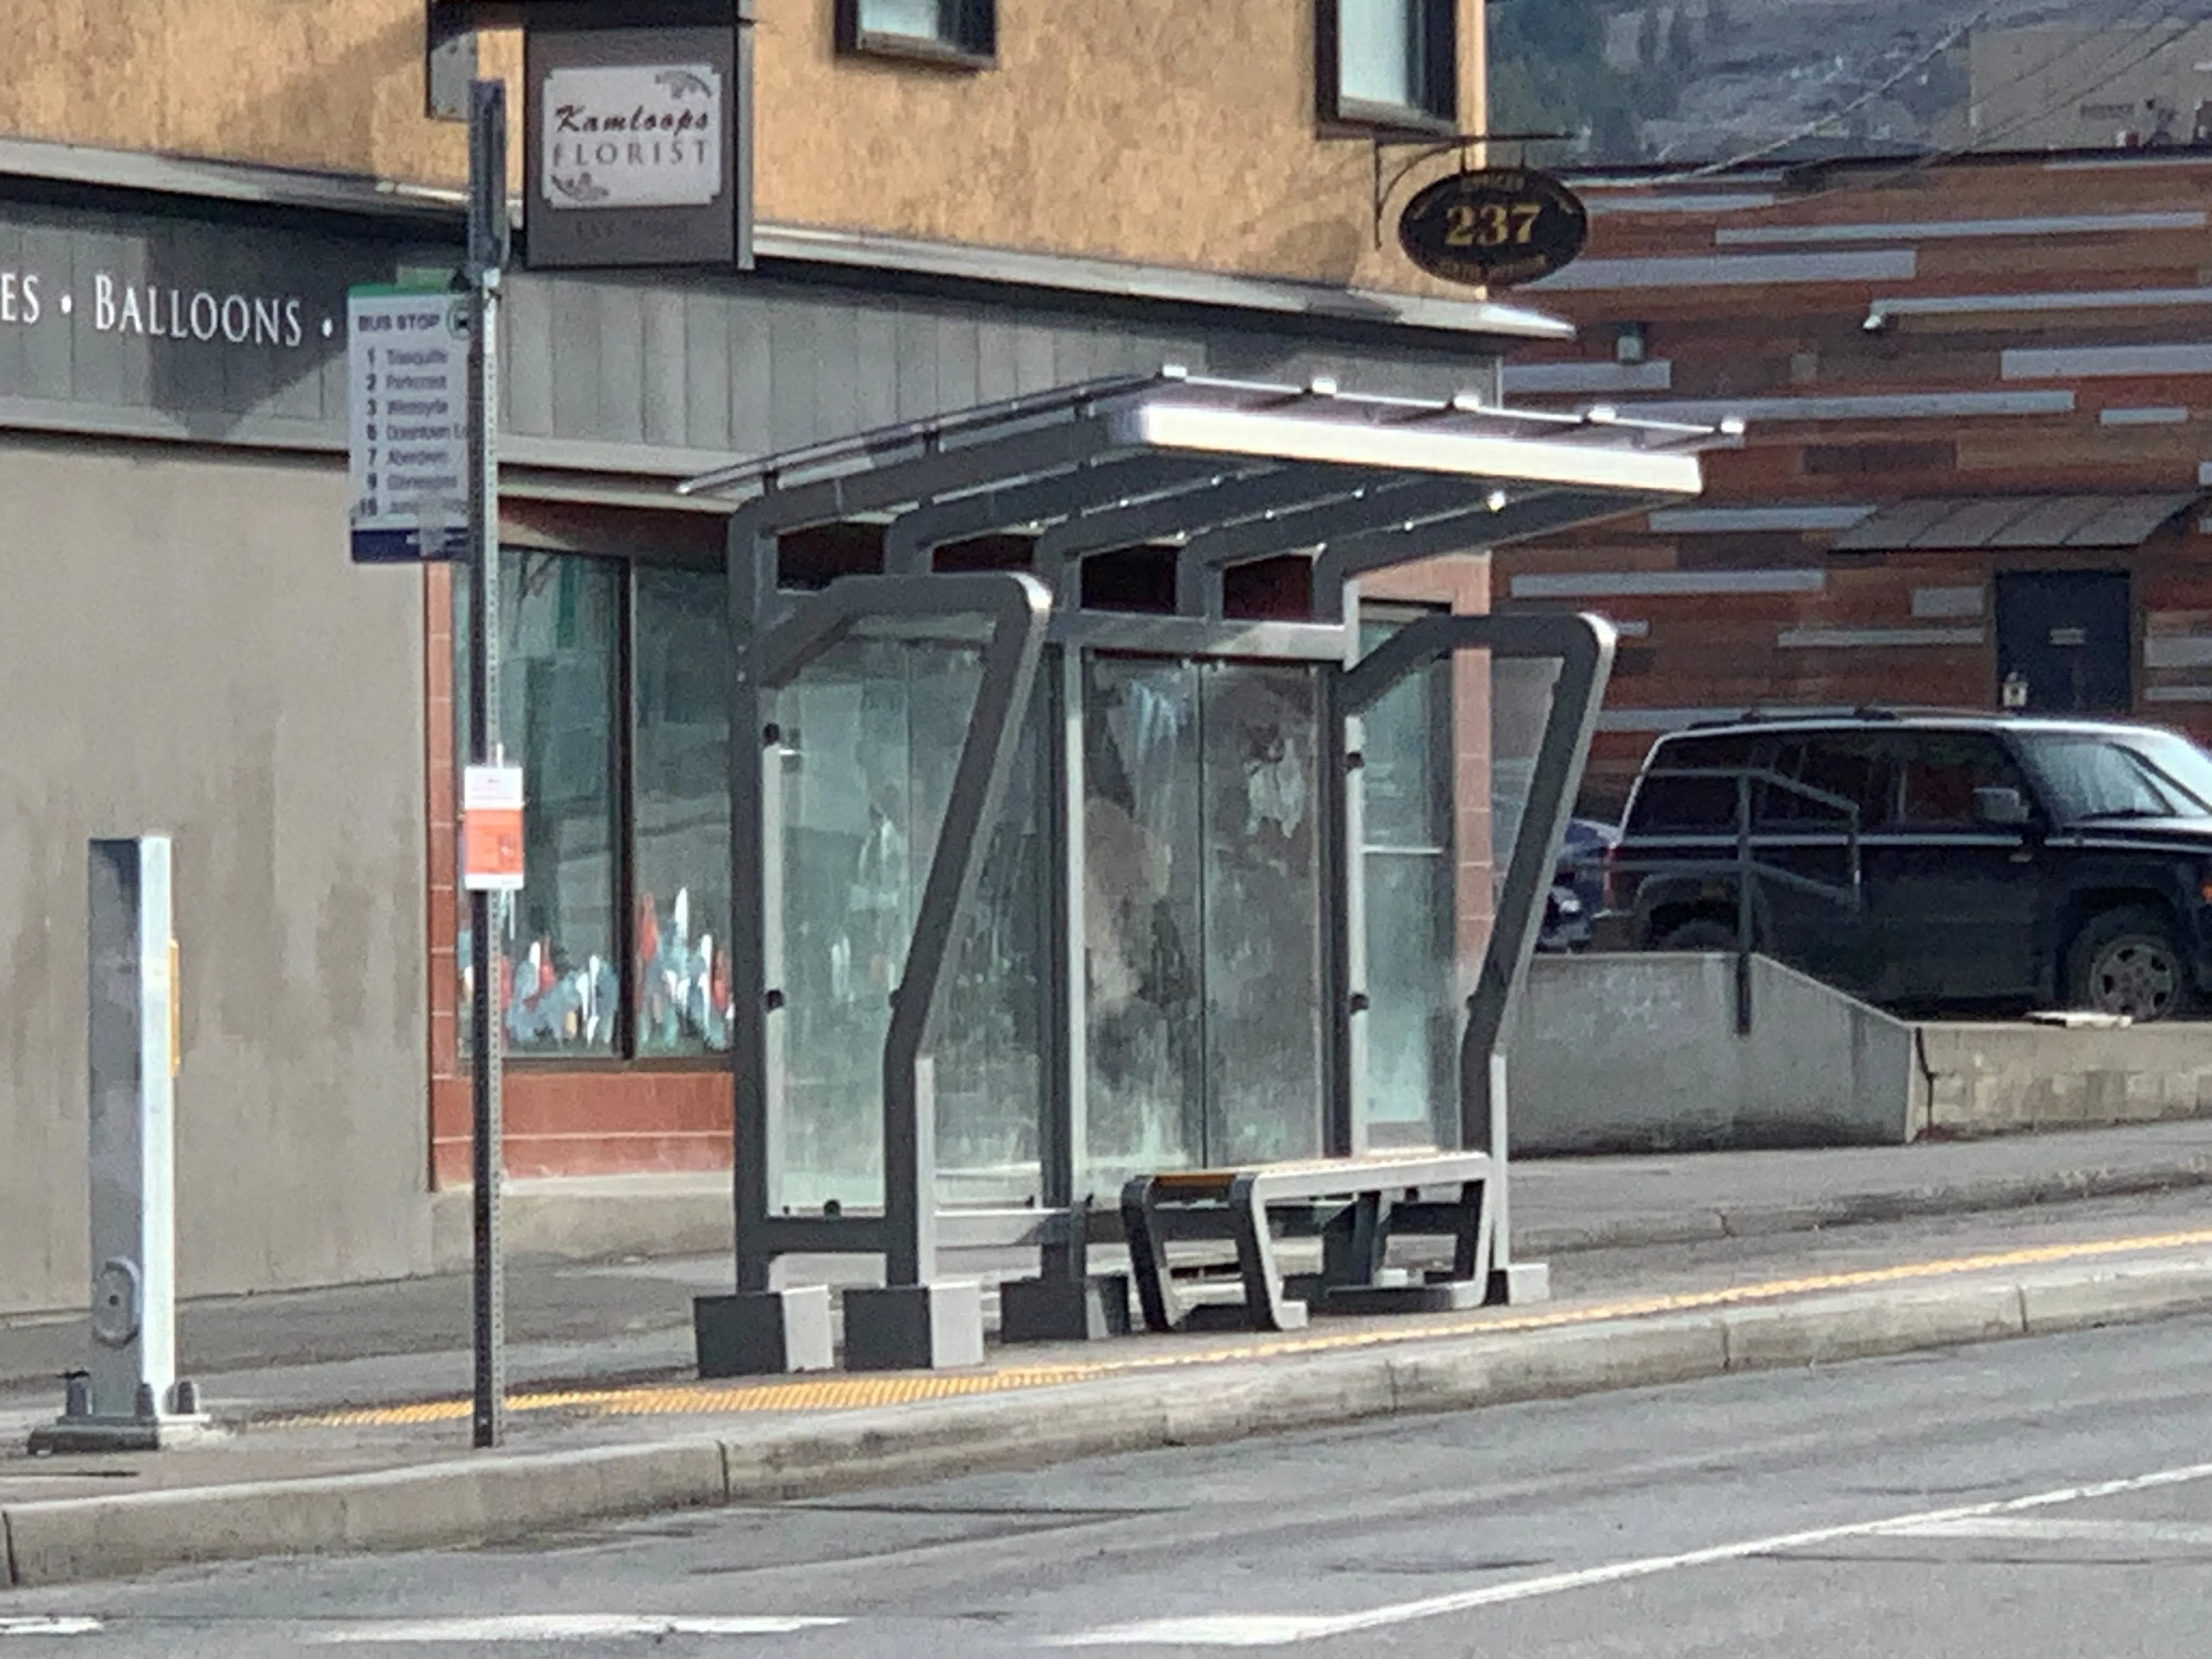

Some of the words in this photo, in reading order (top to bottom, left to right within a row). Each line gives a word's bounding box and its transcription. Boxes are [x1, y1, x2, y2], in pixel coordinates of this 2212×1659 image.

[555, 105, 708, 136] Kamloops
[553, 140, 708, 167] FLORIST
[1445, 202, 1542, 247] 237
[358, 314, 392, 332] BUS
[397, 313, 441, 330] STOP
